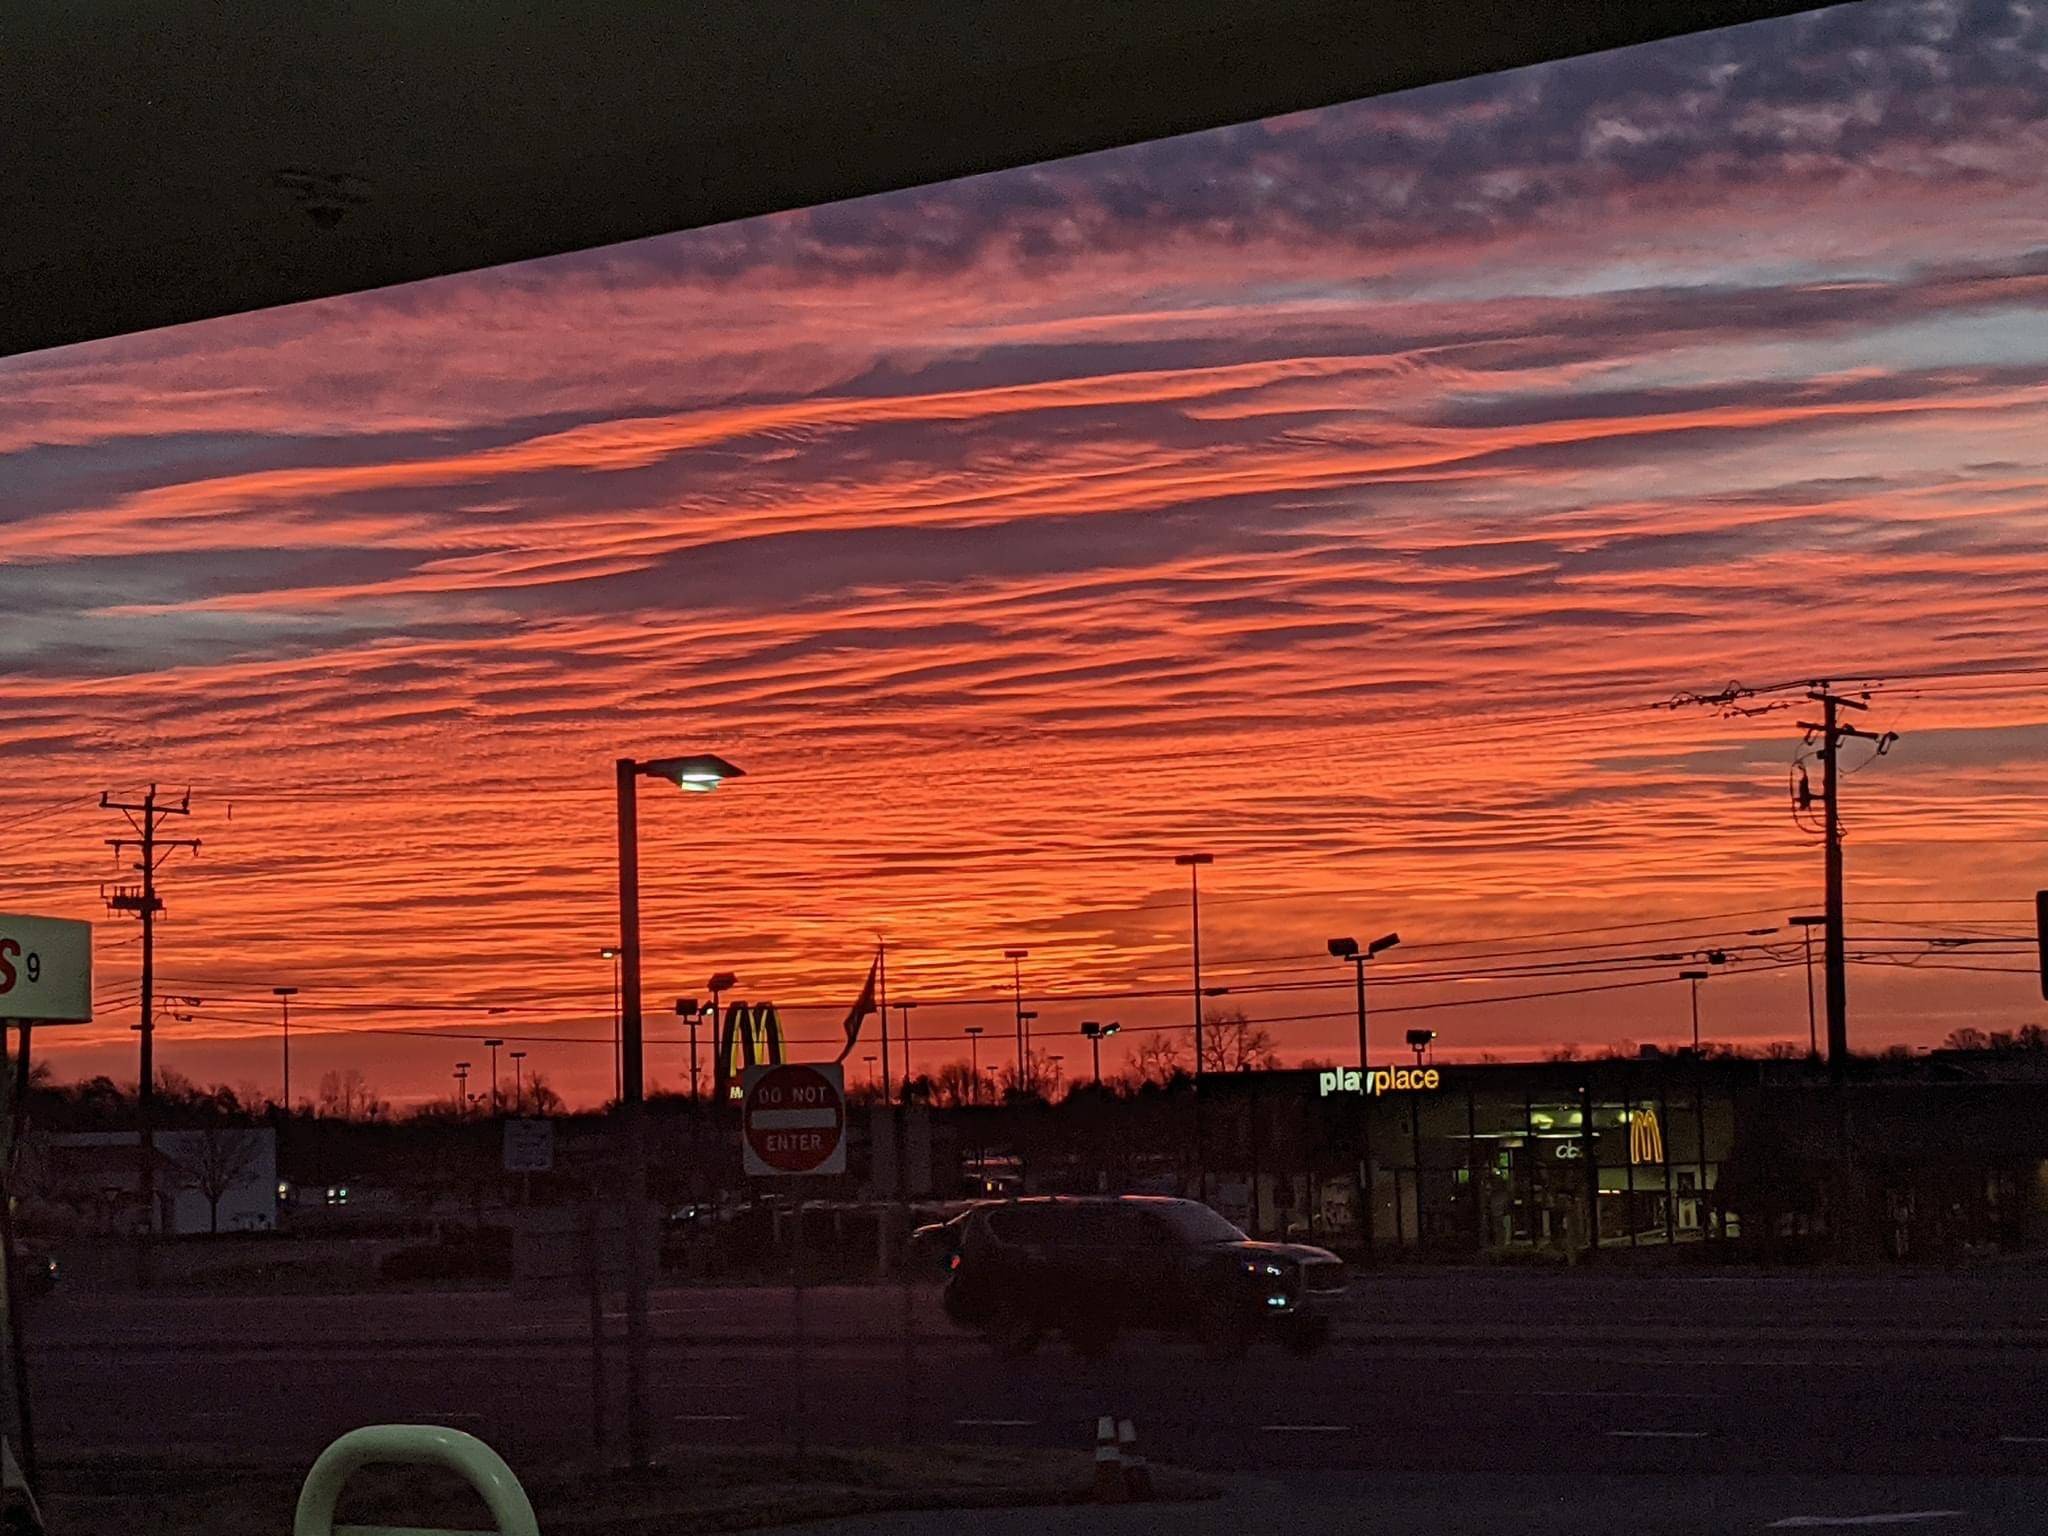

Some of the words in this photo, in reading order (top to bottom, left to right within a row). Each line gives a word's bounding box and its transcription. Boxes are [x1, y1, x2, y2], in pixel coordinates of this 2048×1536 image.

[27, 952, 40, 983] 9
[758, 1087, 783, 1104] DO
[793, 1086, 827, 1103] NOT
[767, 1134, 823, 1152] ENTER
